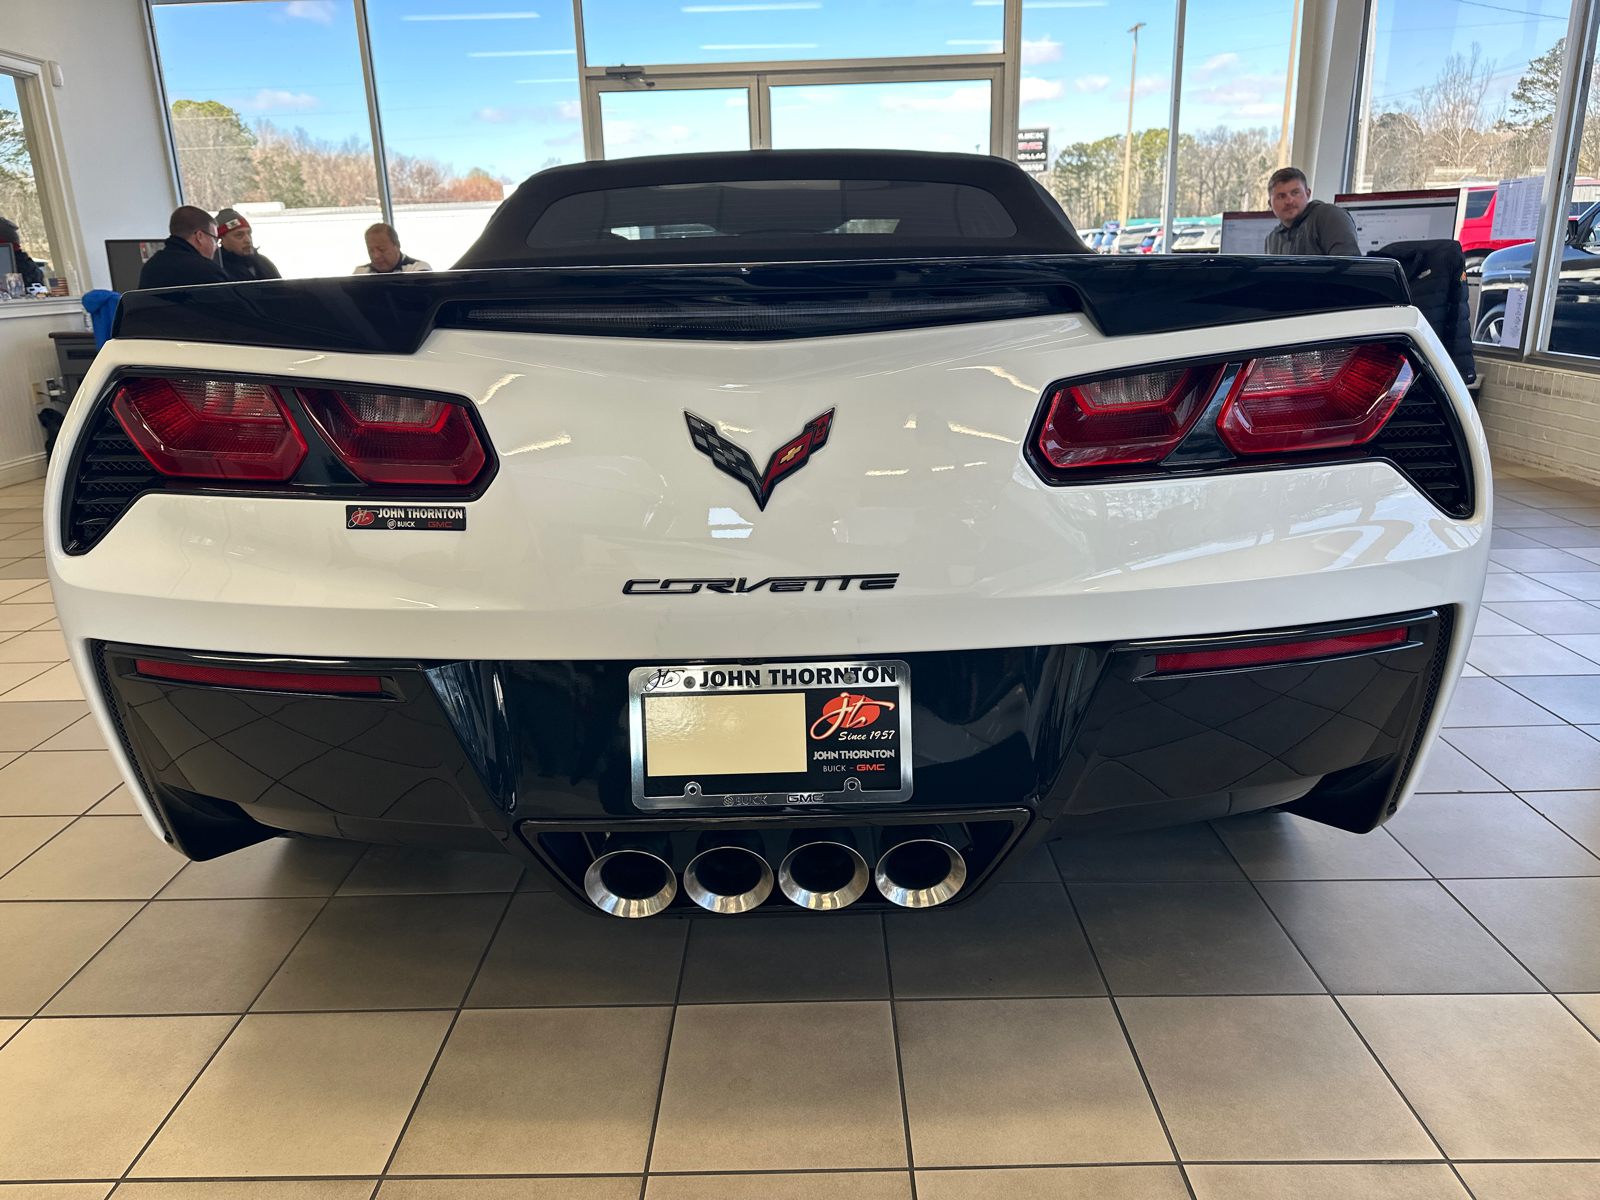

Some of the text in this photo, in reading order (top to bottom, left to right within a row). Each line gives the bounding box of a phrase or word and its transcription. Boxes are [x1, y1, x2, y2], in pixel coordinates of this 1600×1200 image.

[377, 507, 463, 519] JOHN THORNTON
[622, 572, 900, 595] CORVETTE
[699, 666, 896, 688] JOHN THORNTON
[838, 729, 896, 741] Since 1957
[813, 749, 895, 761] JOHN THORNTON
[822, 764, 847, 773] BUICK
[856, 763, 886, 772] GMC
[735, 792, 824, 805] BUICK GMC
